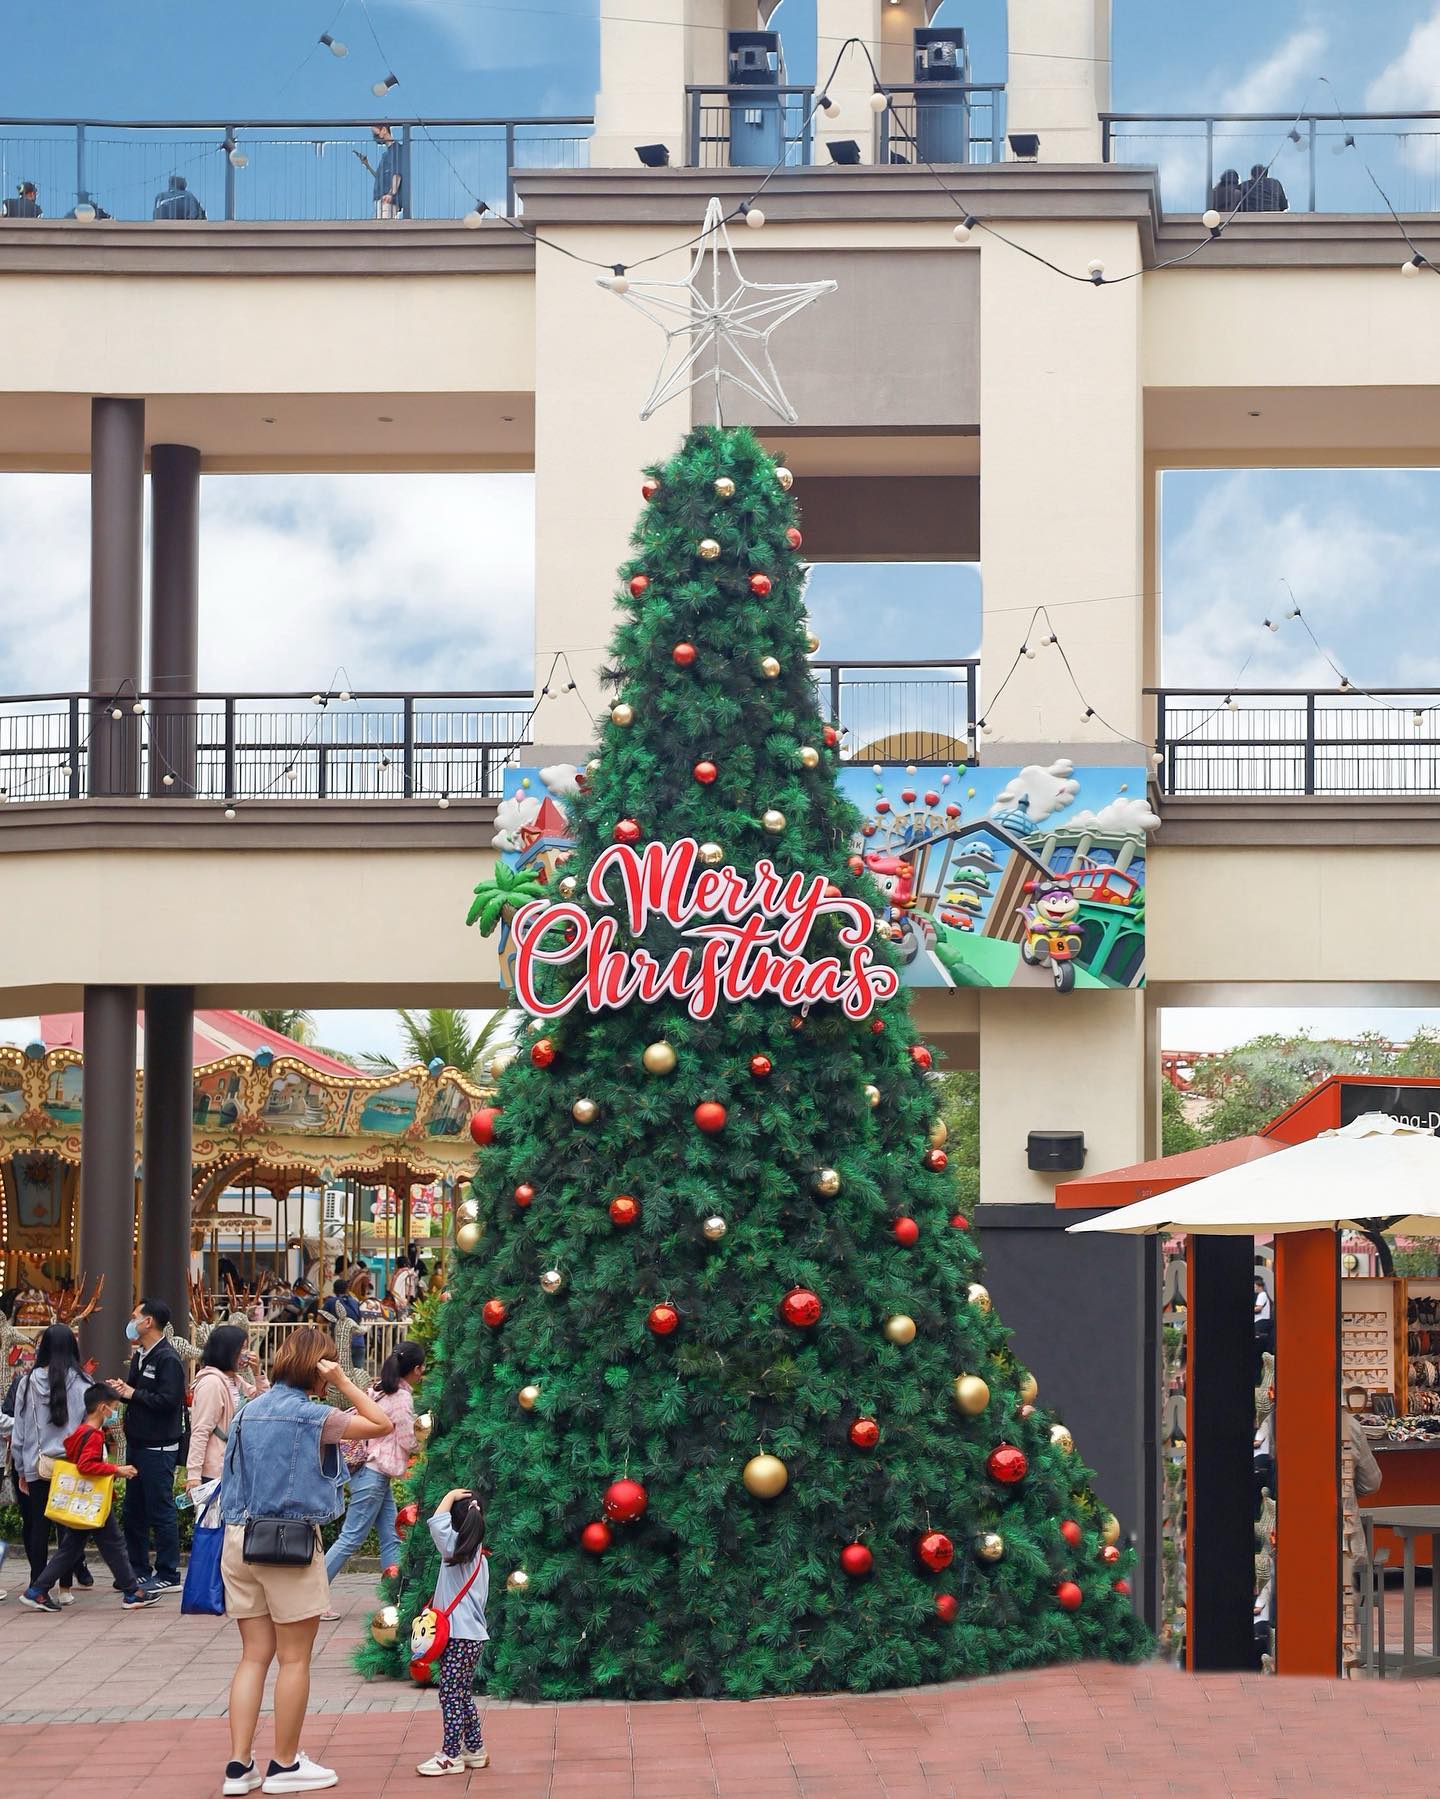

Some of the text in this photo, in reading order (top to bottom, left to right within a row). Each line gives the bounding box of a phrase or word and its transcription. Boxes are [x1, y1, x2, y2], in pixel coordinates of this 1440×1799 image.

[587, 837, 875, 956] Merry
[1057, 941, 1064, 951] 8
[511, 899, 899, 1021] Christmas
